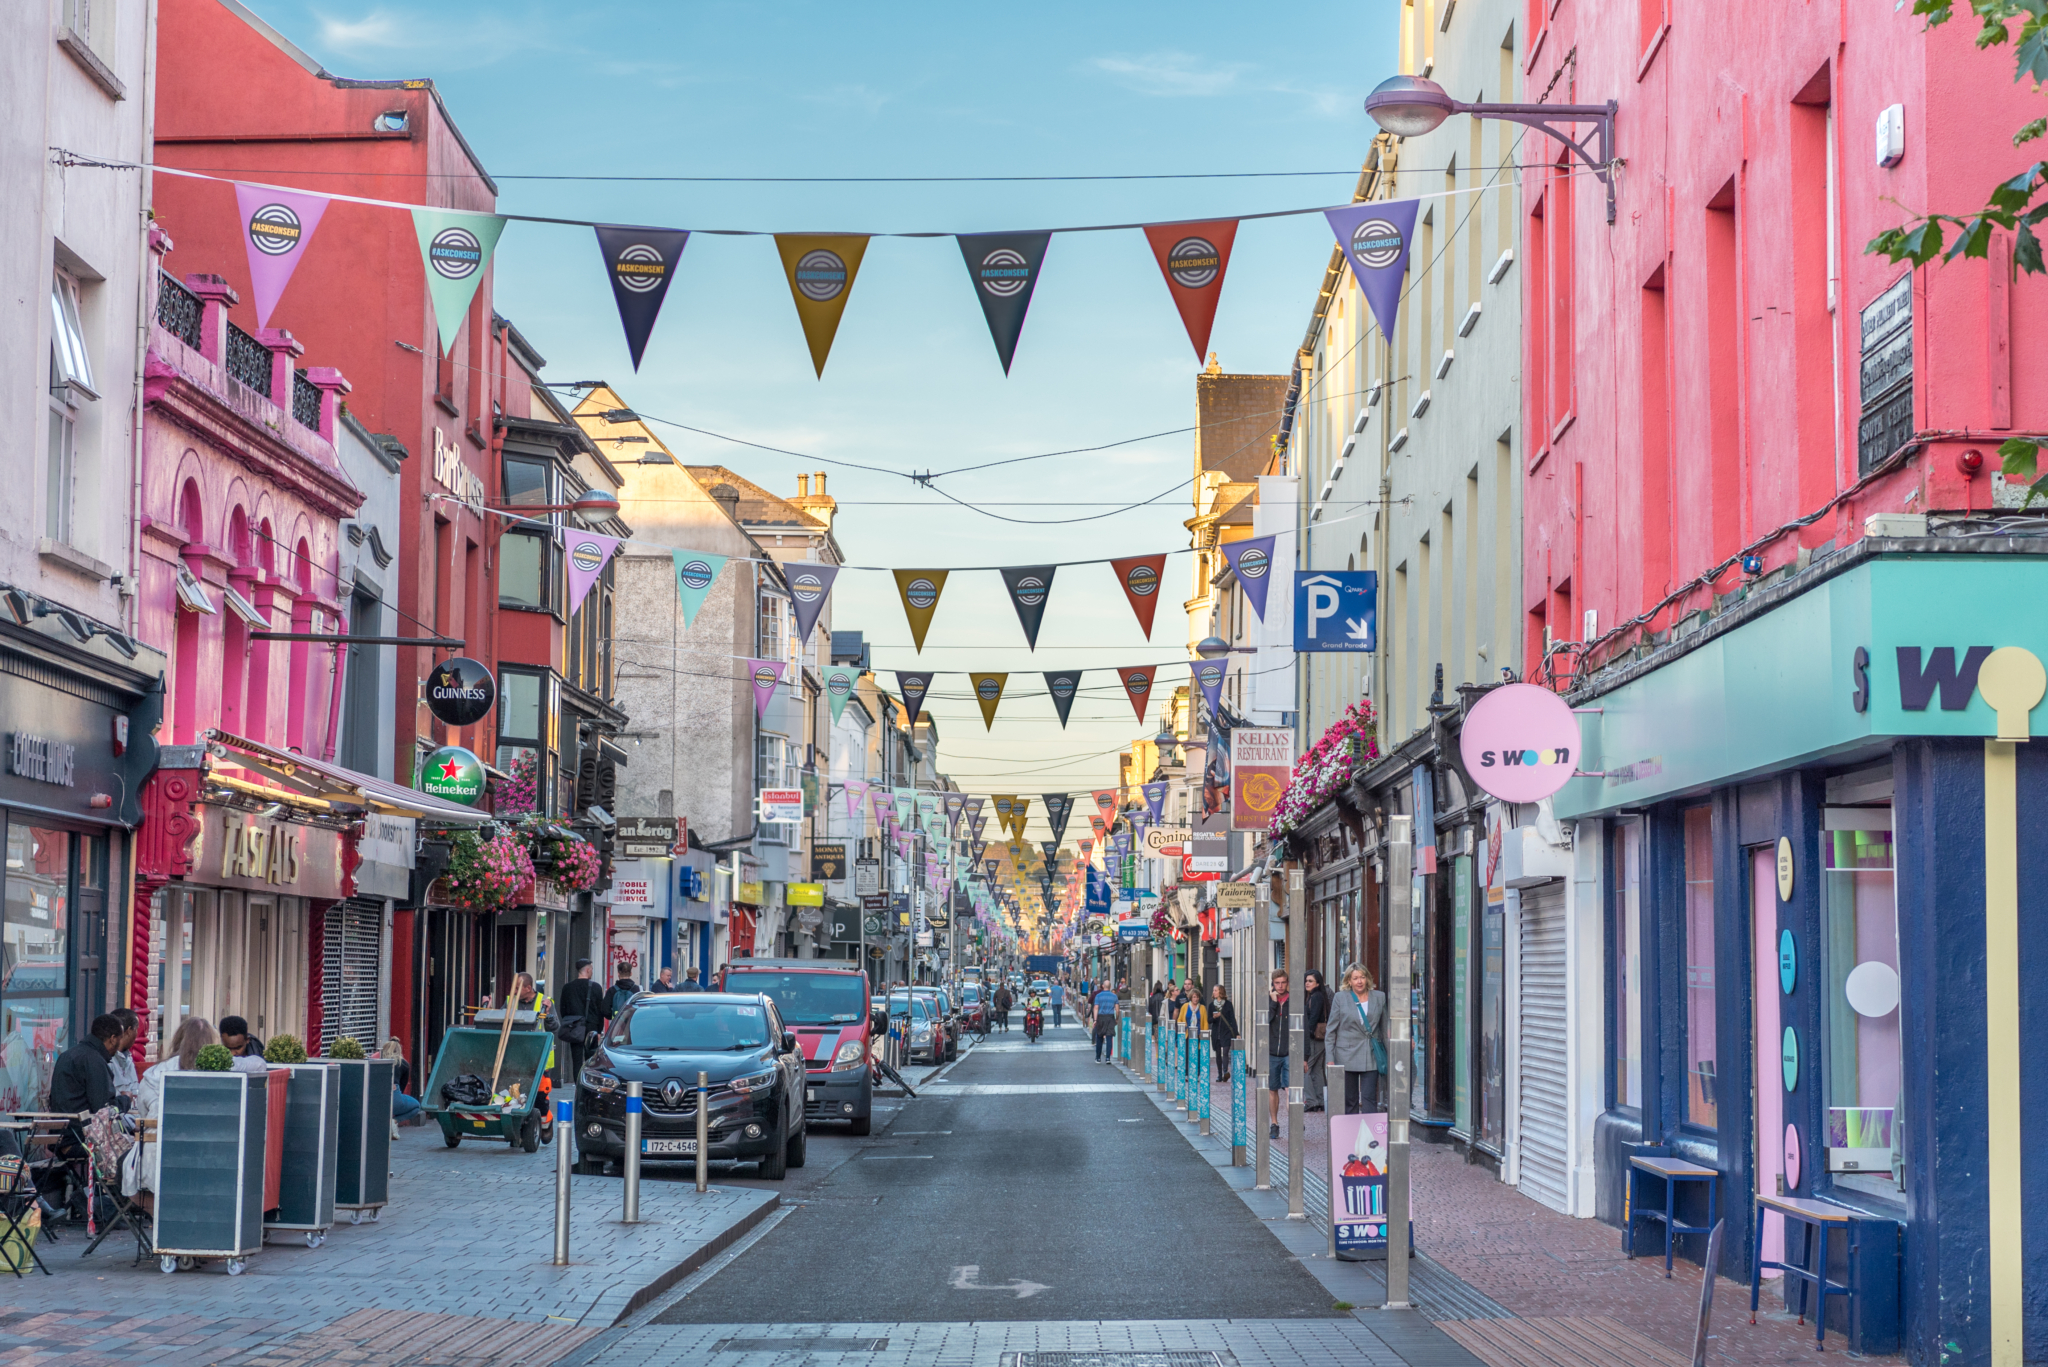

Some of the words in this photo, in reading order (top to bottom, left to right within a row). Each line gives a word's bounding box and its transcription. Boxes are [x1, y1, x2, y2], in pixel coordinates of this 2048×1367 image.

[252, 222, 299, 238] #ASKCONSENT
[1353, 237, 1401, 251] #ASKCONSENT
[432, 247, 480, 261] #ASKCONSENT
[617, 262, 665, 275] #ASKCONSENT
[1170, 257, 1218, 269] #ASKCONSENT
[797, 270, 846, 282] #ASKCONSENT
[981, 268, 1029, 278] #ASKCONSENT
[1307, 585, 1340, 639] P
[433, 686, 485, 699] GUINNESS
[1237, 733, 1289, 746] KELLYS
[13, 731, 47, 782] COFFEE
[47, 739, 75, 788] HOUSE
[1237, 747, 1289, 761] RESTAURANT
[425, 783, 478, 796] Heineken
[764, 792, 799, 800] Istanbul
[1218, 888, 1256, 898] Tailoring
[651, 1140, 698, 1151] 172-C-4548
